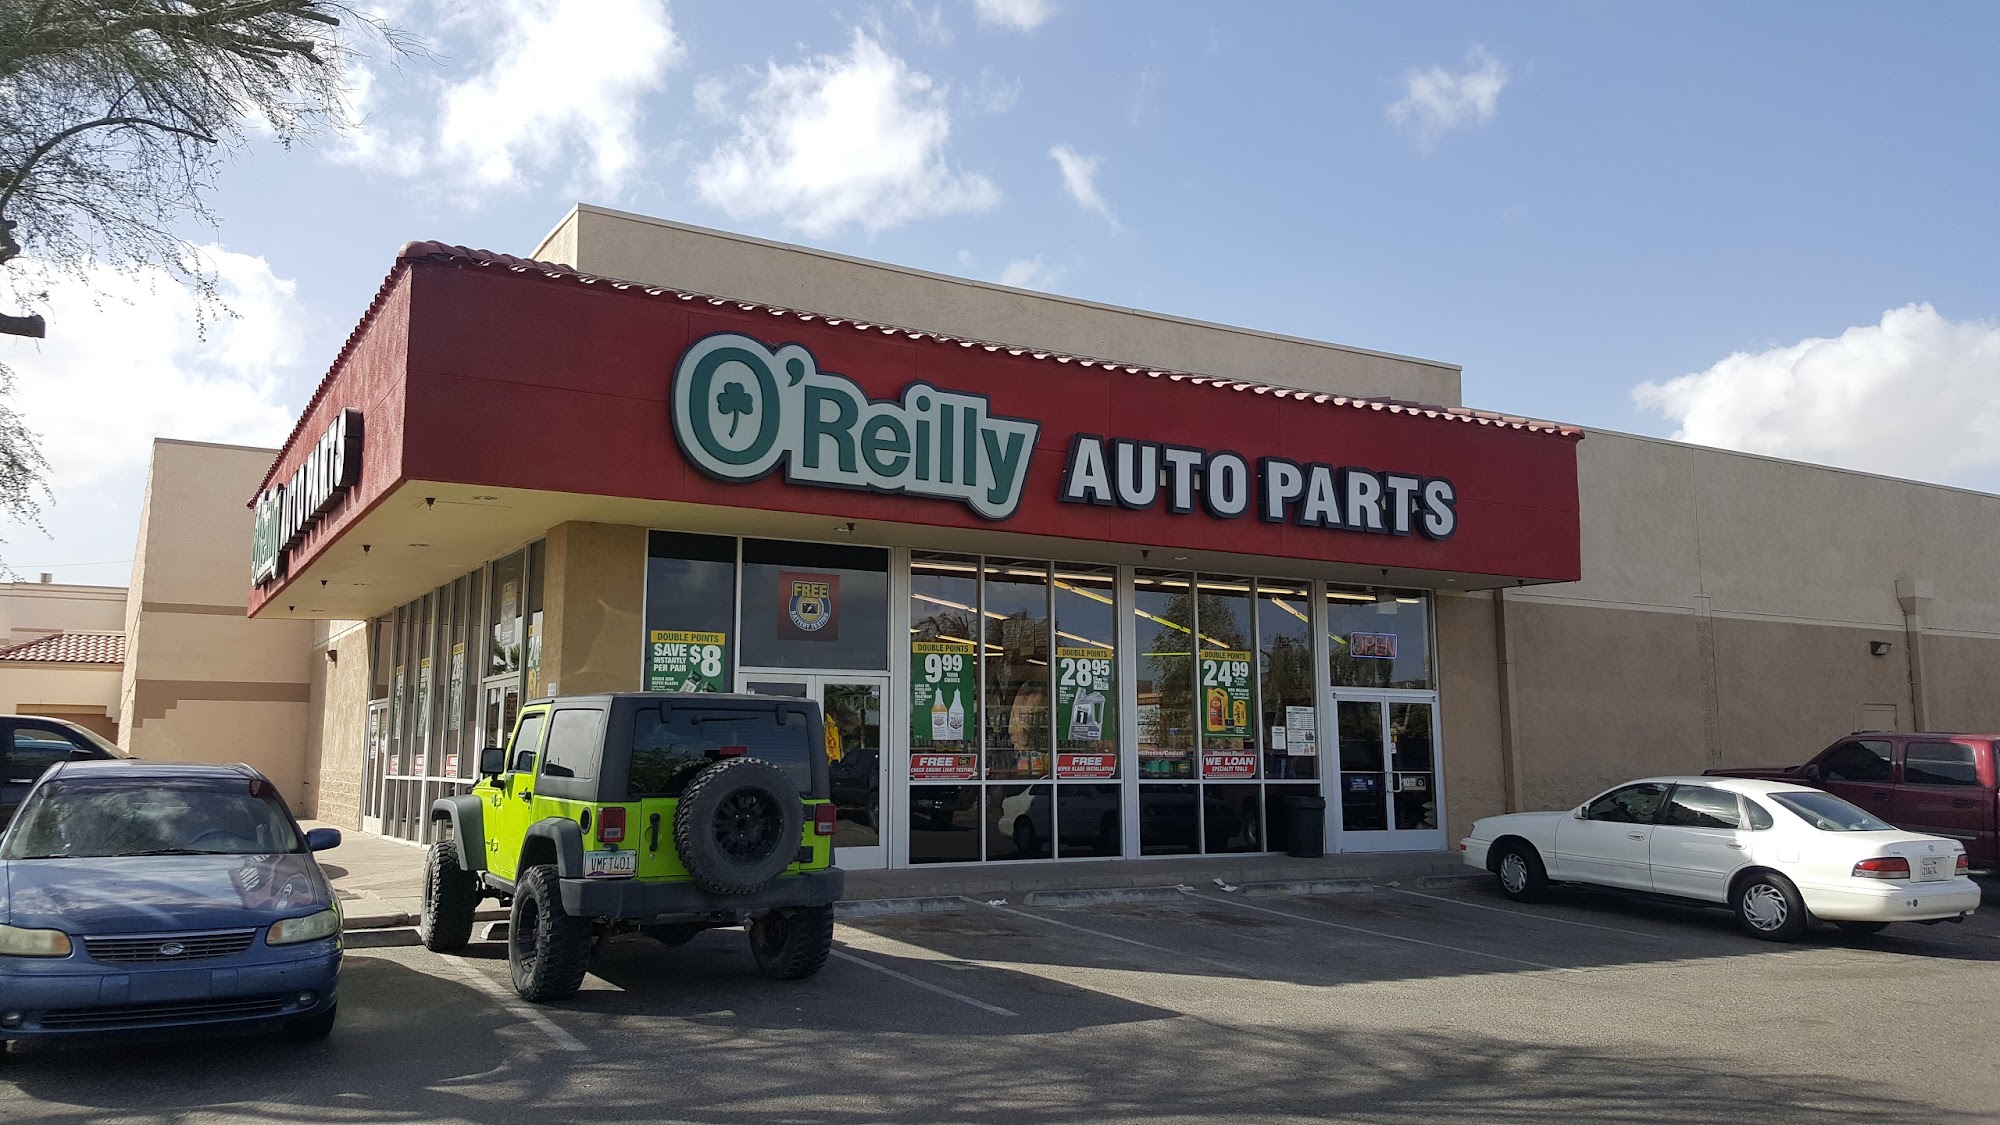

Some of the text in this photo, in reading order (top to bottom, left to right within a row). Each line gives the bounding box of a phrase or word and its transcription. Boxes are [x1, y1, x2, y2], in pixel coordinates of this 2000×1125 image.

[689, 347, 1455, 538] O'Reilly AUTO PARTS
[306, 408, 348, 522] PARTS
[793, 582, 829, 599] FREE
[657, 632, 720, 643] DOUBLE POINTS
[654, 643, 688, 657] SAVE
[917, 643, 969, 653] DOUBLE POINTS
[1352, 634, 1396, 657] OPEN
[1062, 649, 1108, 658] DOUBLE POINTS
[1204, 651, 1226, 659] DOUBLE
[689, 644, 722, 678] $8
[653, 664, 687, 672] PER PAIR
[919, 757, 954, 767] FREE
[1072, 756, 1103, 766] FREE
[1205, 757, 1254, 766] WE LOAN
